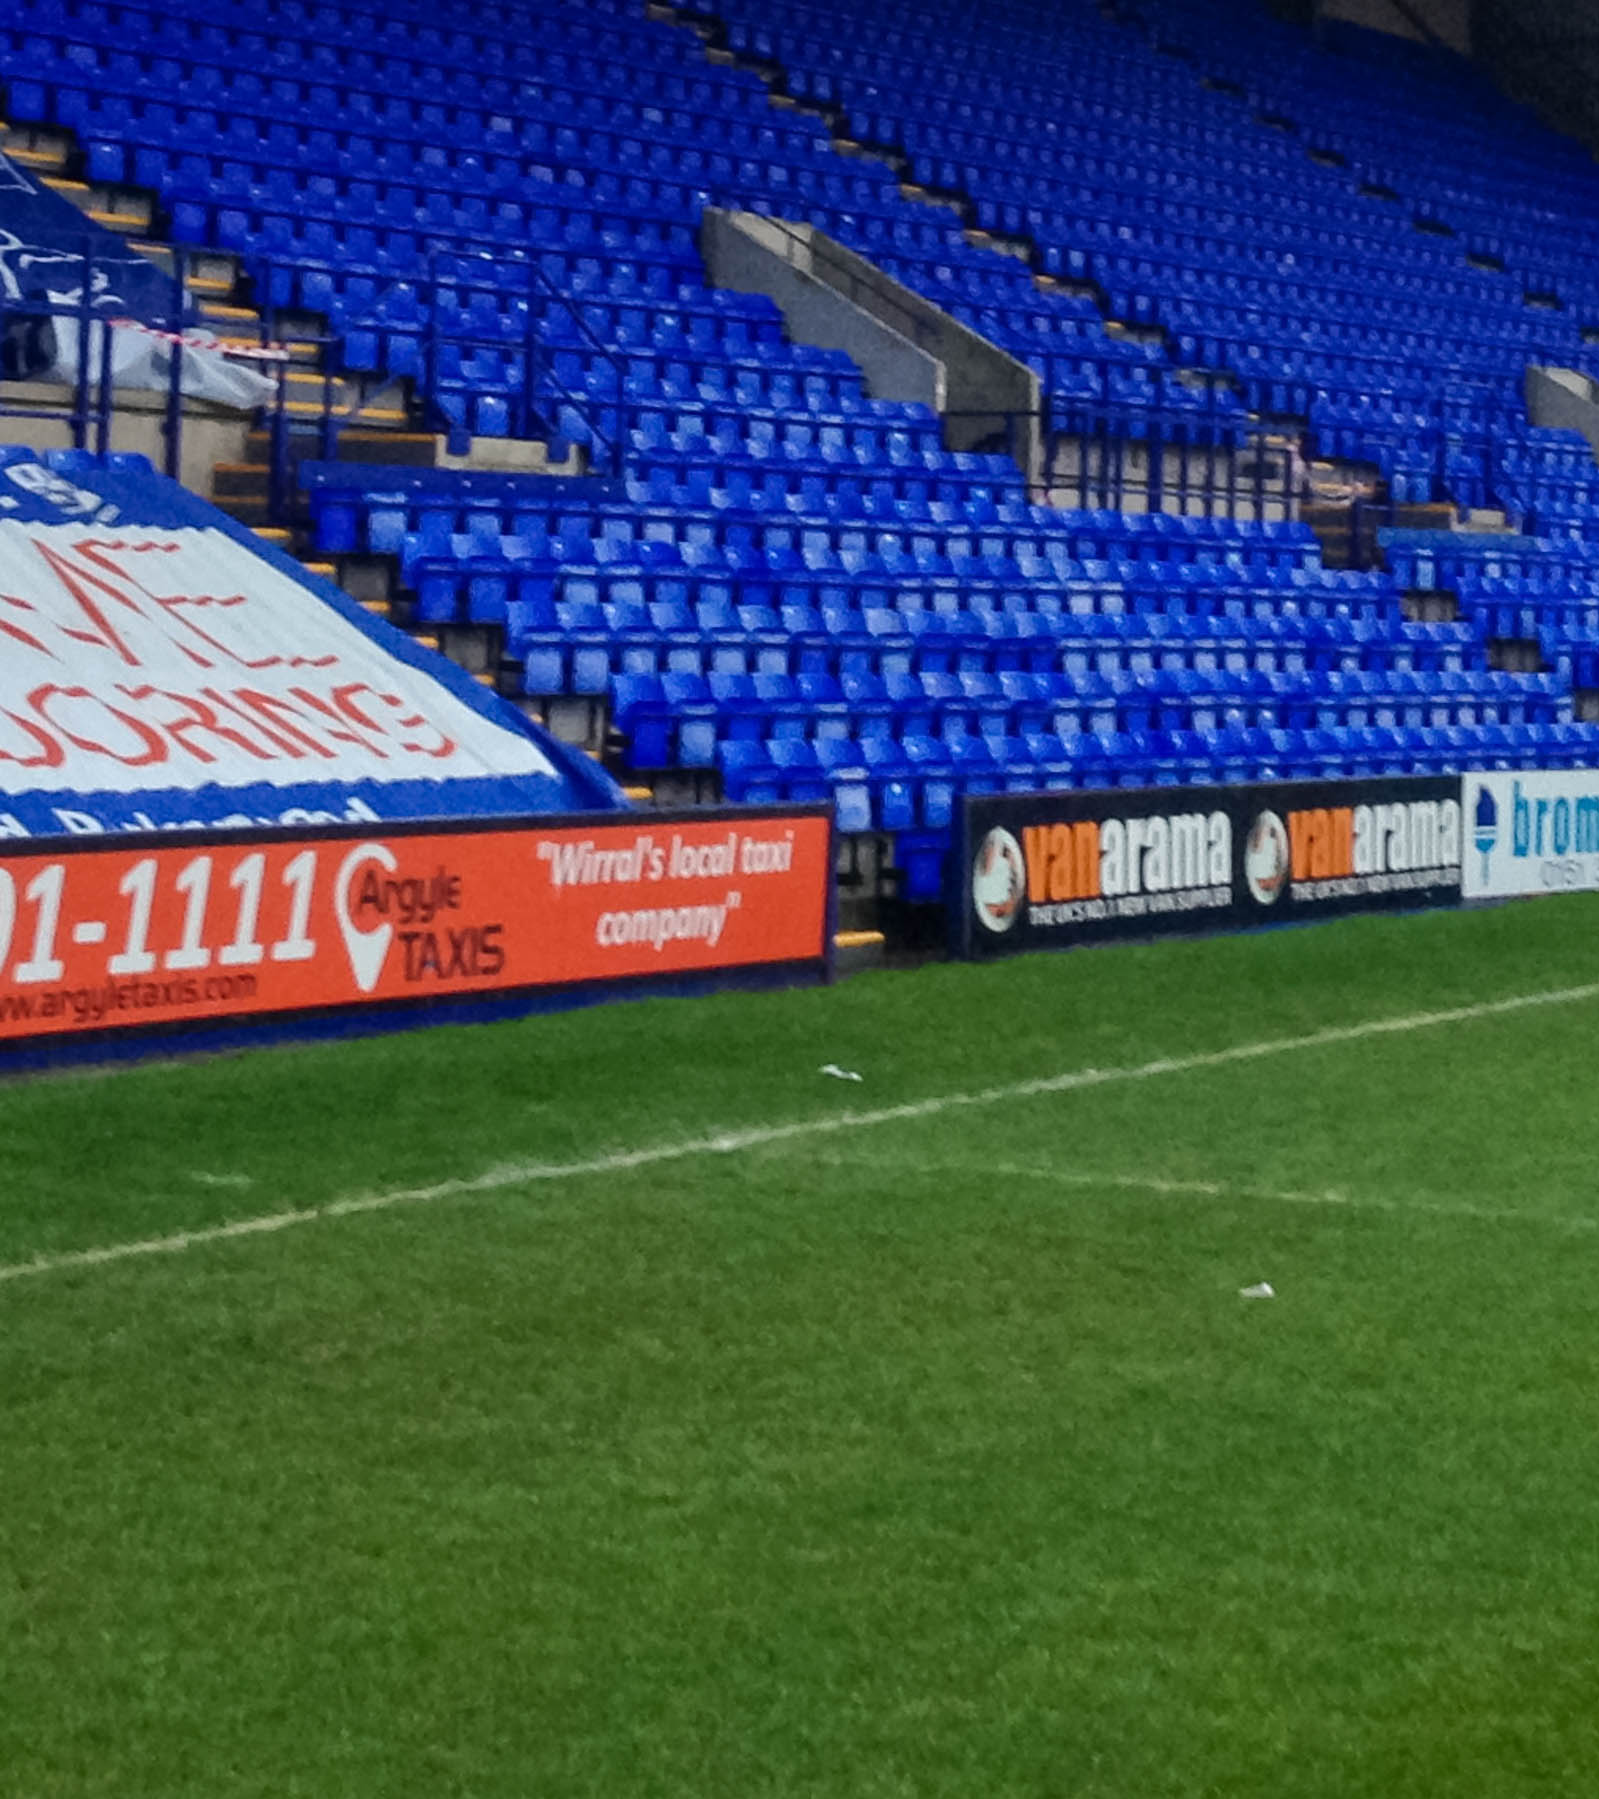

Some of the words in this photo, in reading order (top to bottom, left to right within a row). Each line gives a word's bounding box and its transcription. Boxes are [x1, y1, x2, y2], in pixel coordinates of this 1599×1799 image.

[669, 833, 736, 879] local
[741, 830, 795, 874] taxi
[359, 866, 461, 924] Argyle
[398, 925, 506, 982] TAXIS
